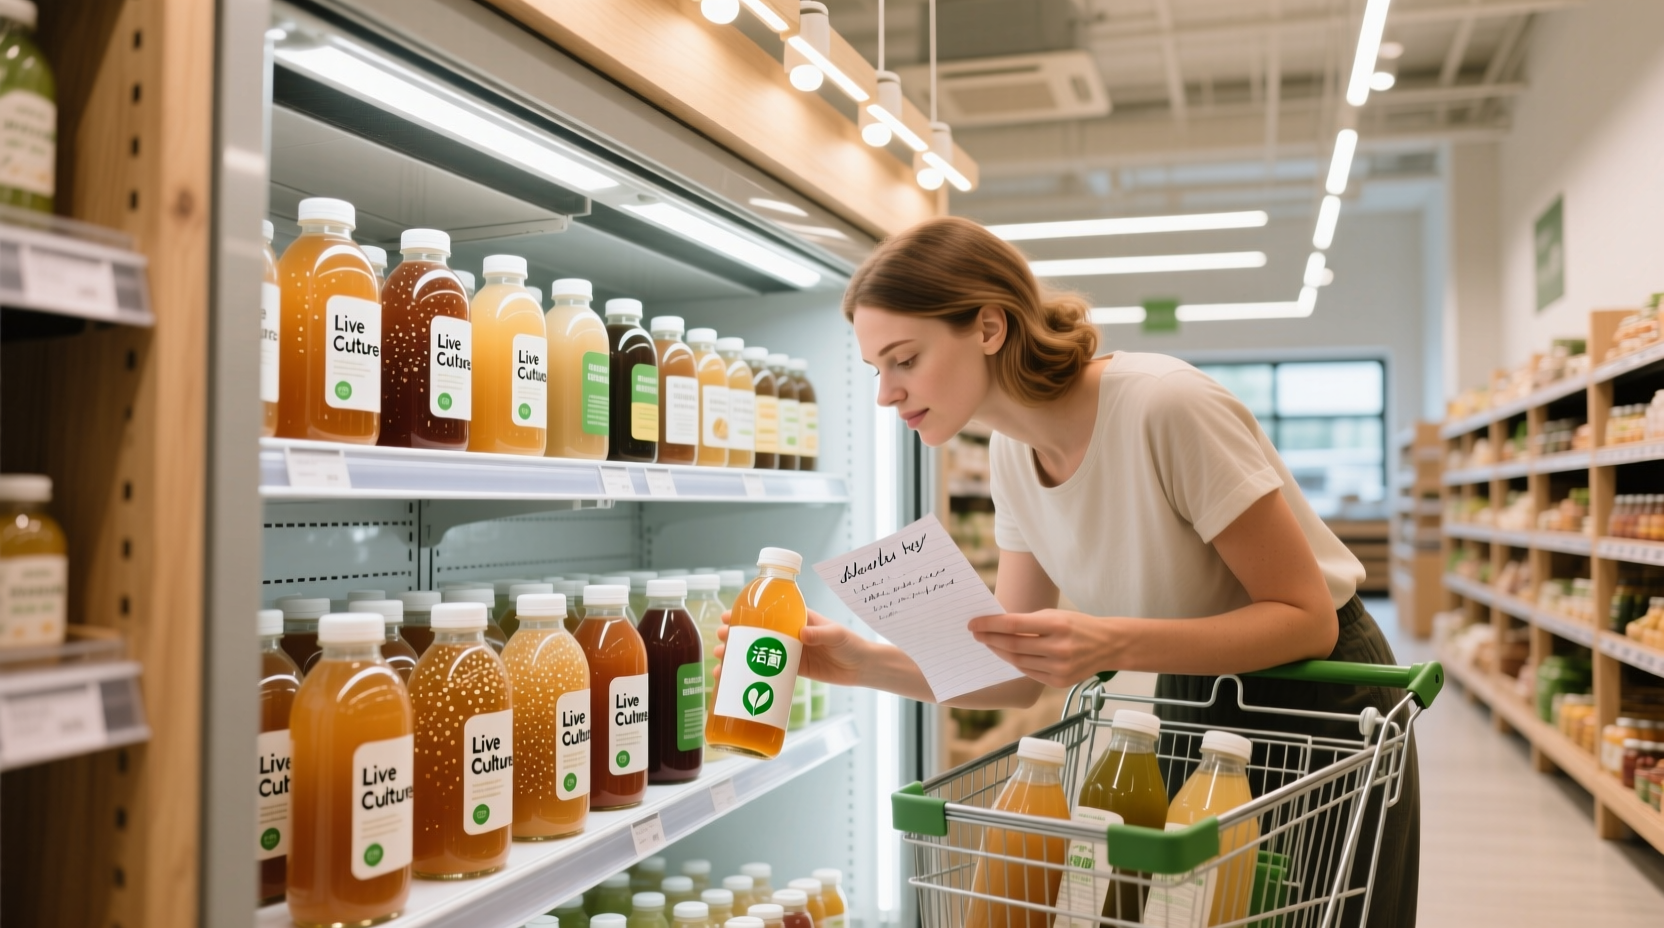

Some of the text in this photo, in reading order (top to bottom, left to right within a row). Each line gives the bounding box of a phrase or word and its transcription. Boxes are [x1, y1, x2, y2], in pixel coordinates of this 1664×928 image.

[335, 315, 365, 334] Live
[437, 333, 461, 351] Live
[518, 349, 539, 366] Live
[616, 692, 640, 709] Live
[562, 710, 586, 728] Live
[472, 734, 501, 755] Live
[362, 764, 397, 787] Live
